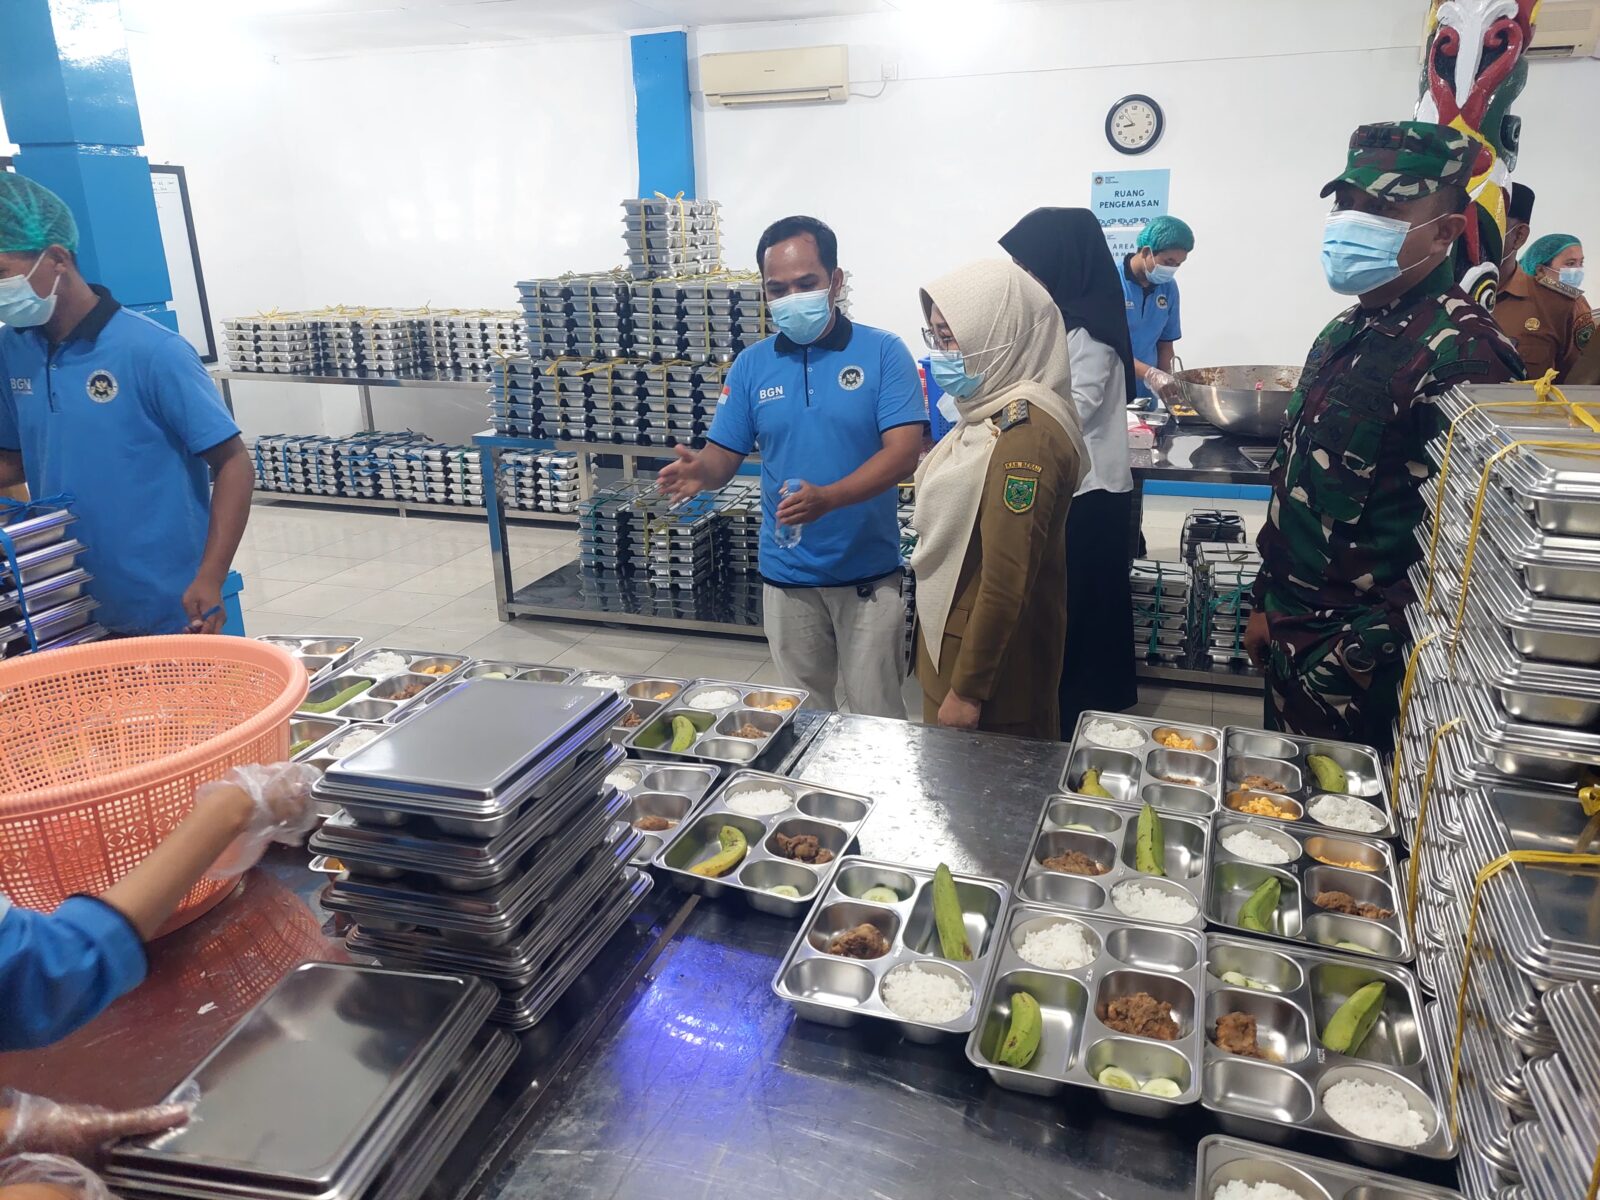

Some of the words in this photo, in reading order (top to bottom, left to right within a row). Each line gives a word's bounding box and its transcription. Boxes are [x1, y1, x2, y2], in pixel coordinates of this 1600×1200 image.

[1114, 189, 1145, 198] RUANG
[1099, 199, 1160, 209] PENGEMASAN
[10, 377, 32, 390] BGN
[759, 385, 784, 400] BGN
